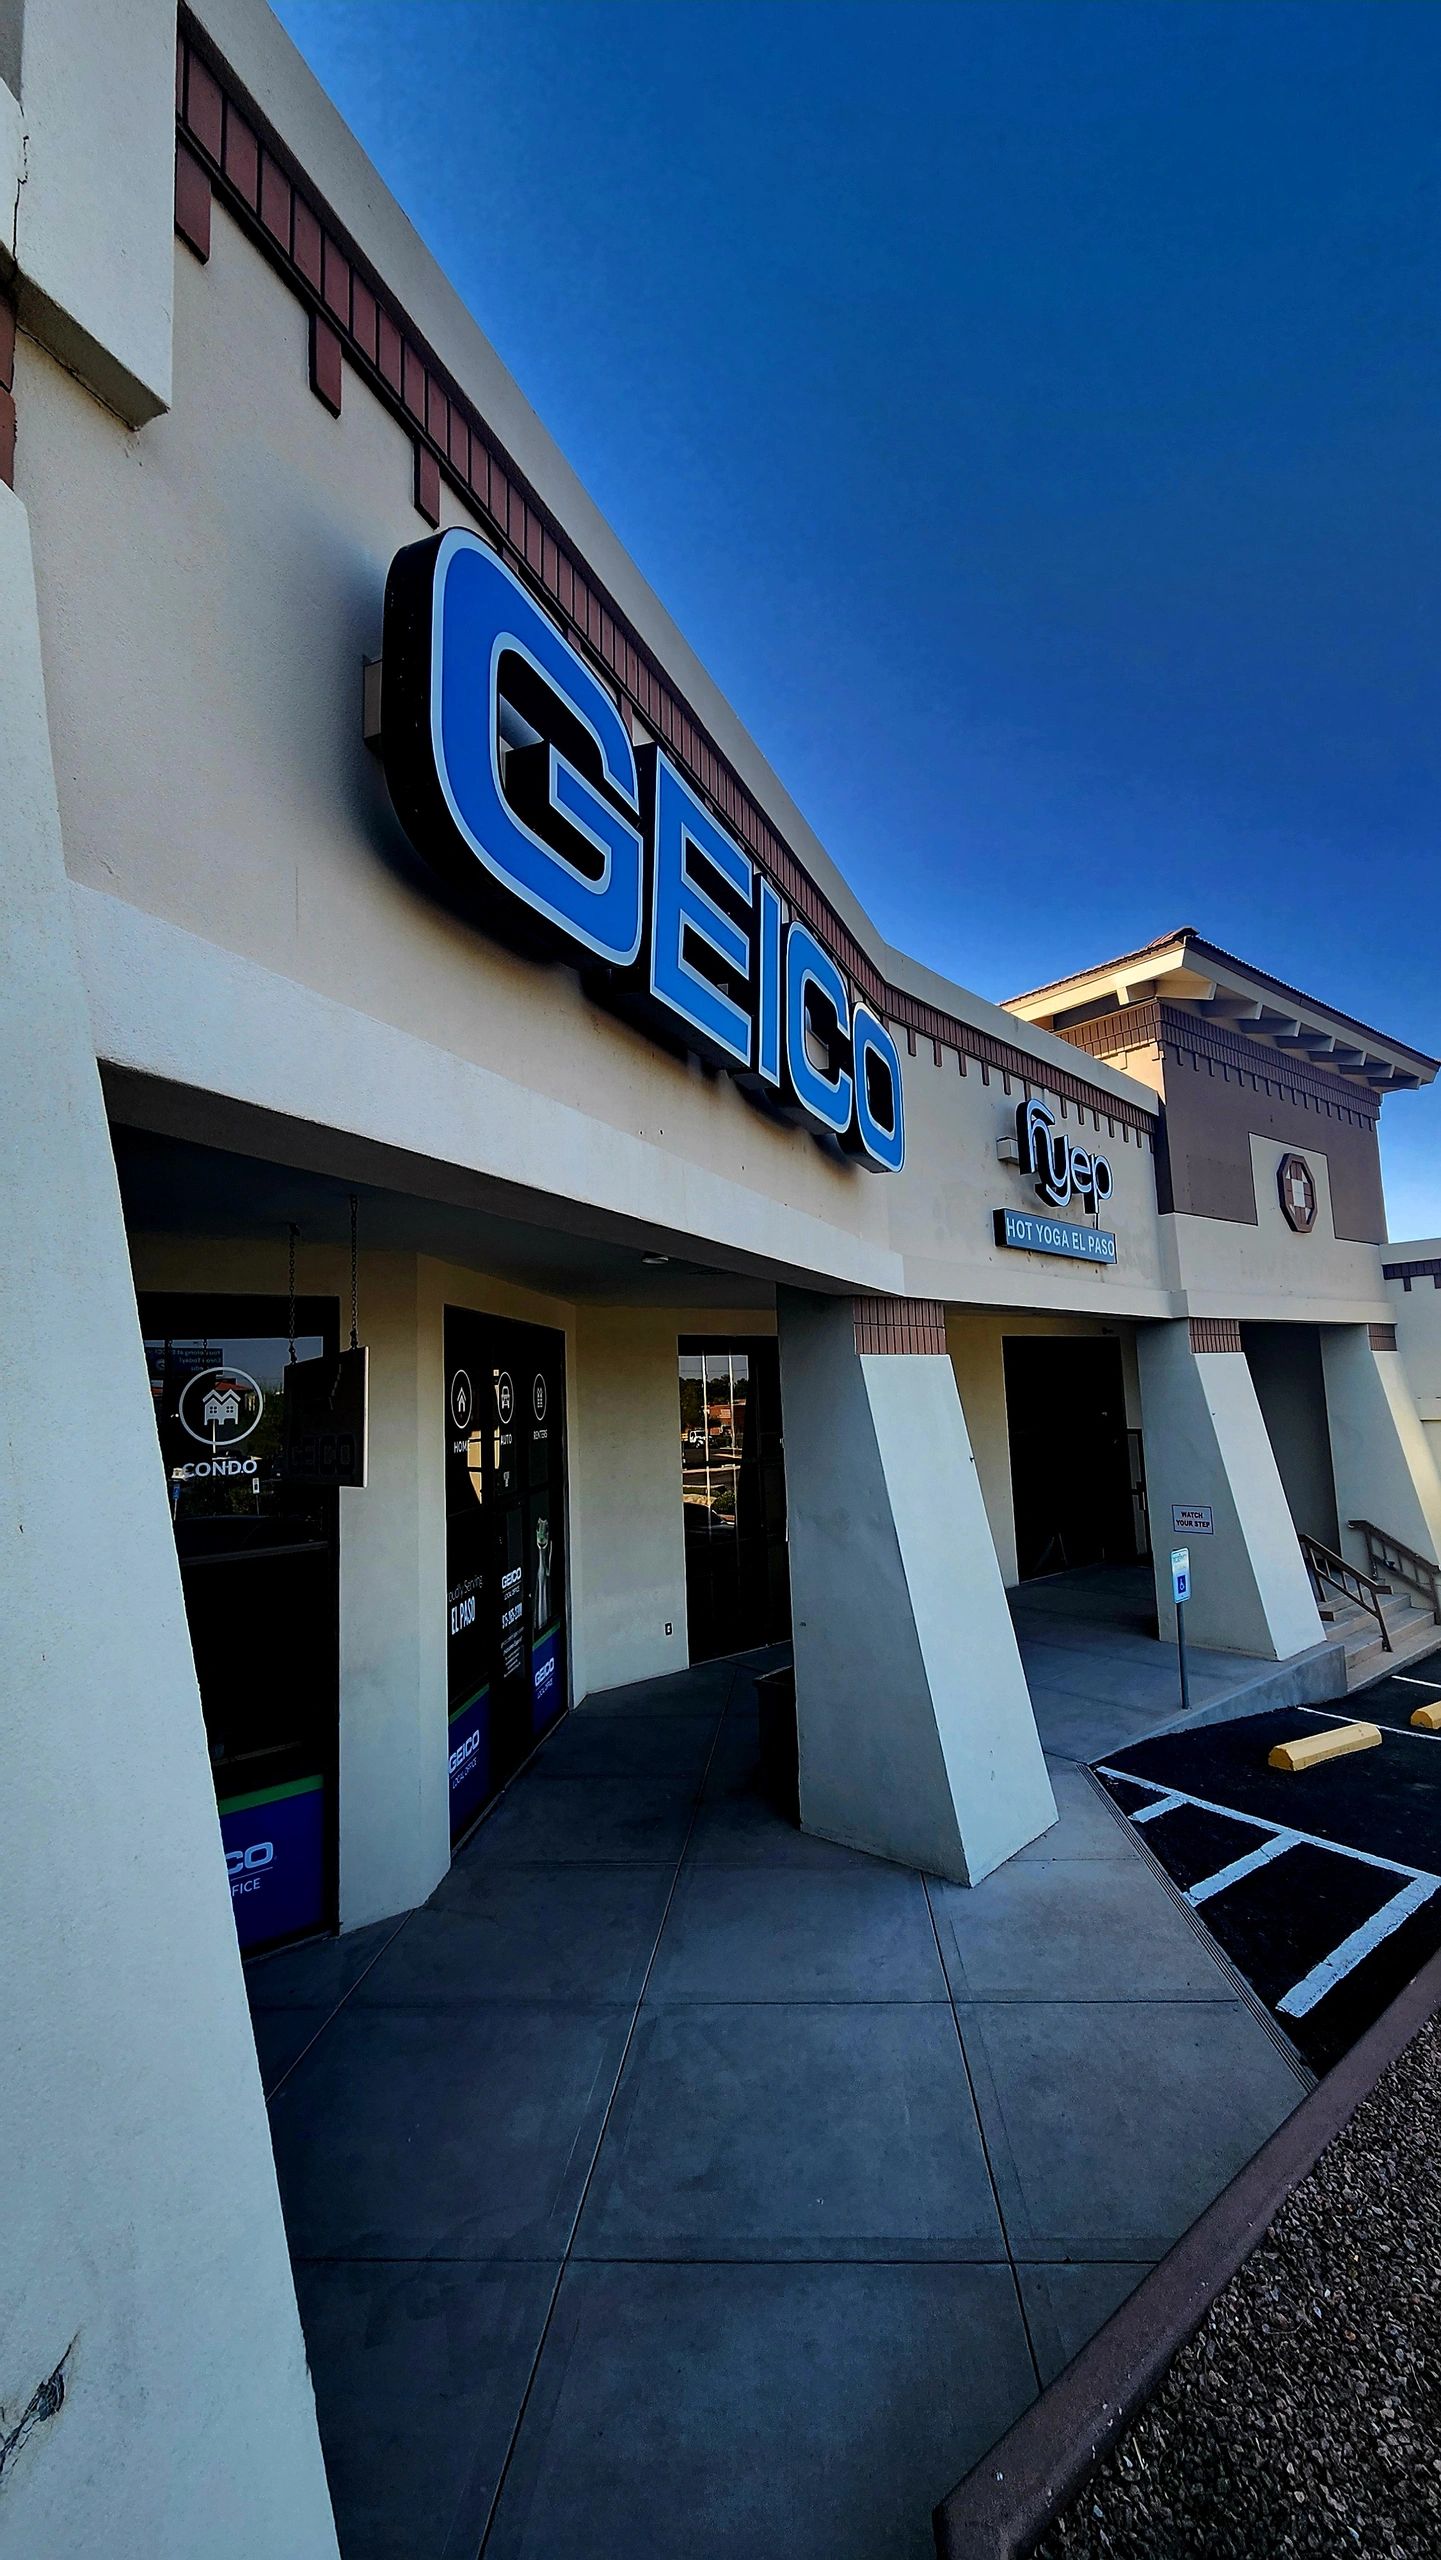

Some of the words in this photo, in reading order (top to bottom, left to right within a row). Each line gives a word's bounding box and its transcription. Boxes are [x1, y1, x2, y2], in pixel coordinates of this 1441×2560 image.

[431, 527, 905, 1174] GEICO
[1006, 1217, 1033, 1240] HOT
[1036, 1223, 1070, 1248] YOGA
[1072, 1232, 1086, 1251] EL
[1088, 1236, 1115, 1257] PASO
[453, 1438, 470, 1454] HOM
[500, 1434, 513, 1445] AUTO
[182, 1459, 258, 1478] CONDO
[1176, 1519, 1193, 1527] YOUR
[1194, 1520, 1210, 1528] STEP
[1181, 1511, 1203, 1519] WATCH
[502, 1567, 522, 1590] GEICO
[451, 1606, 459, 1635] EL
[460, 1596, 476, 1629] PASO
[535, 1657, 554, 1687] GEICO
[448, 1729, 480, 1774] GEICO
